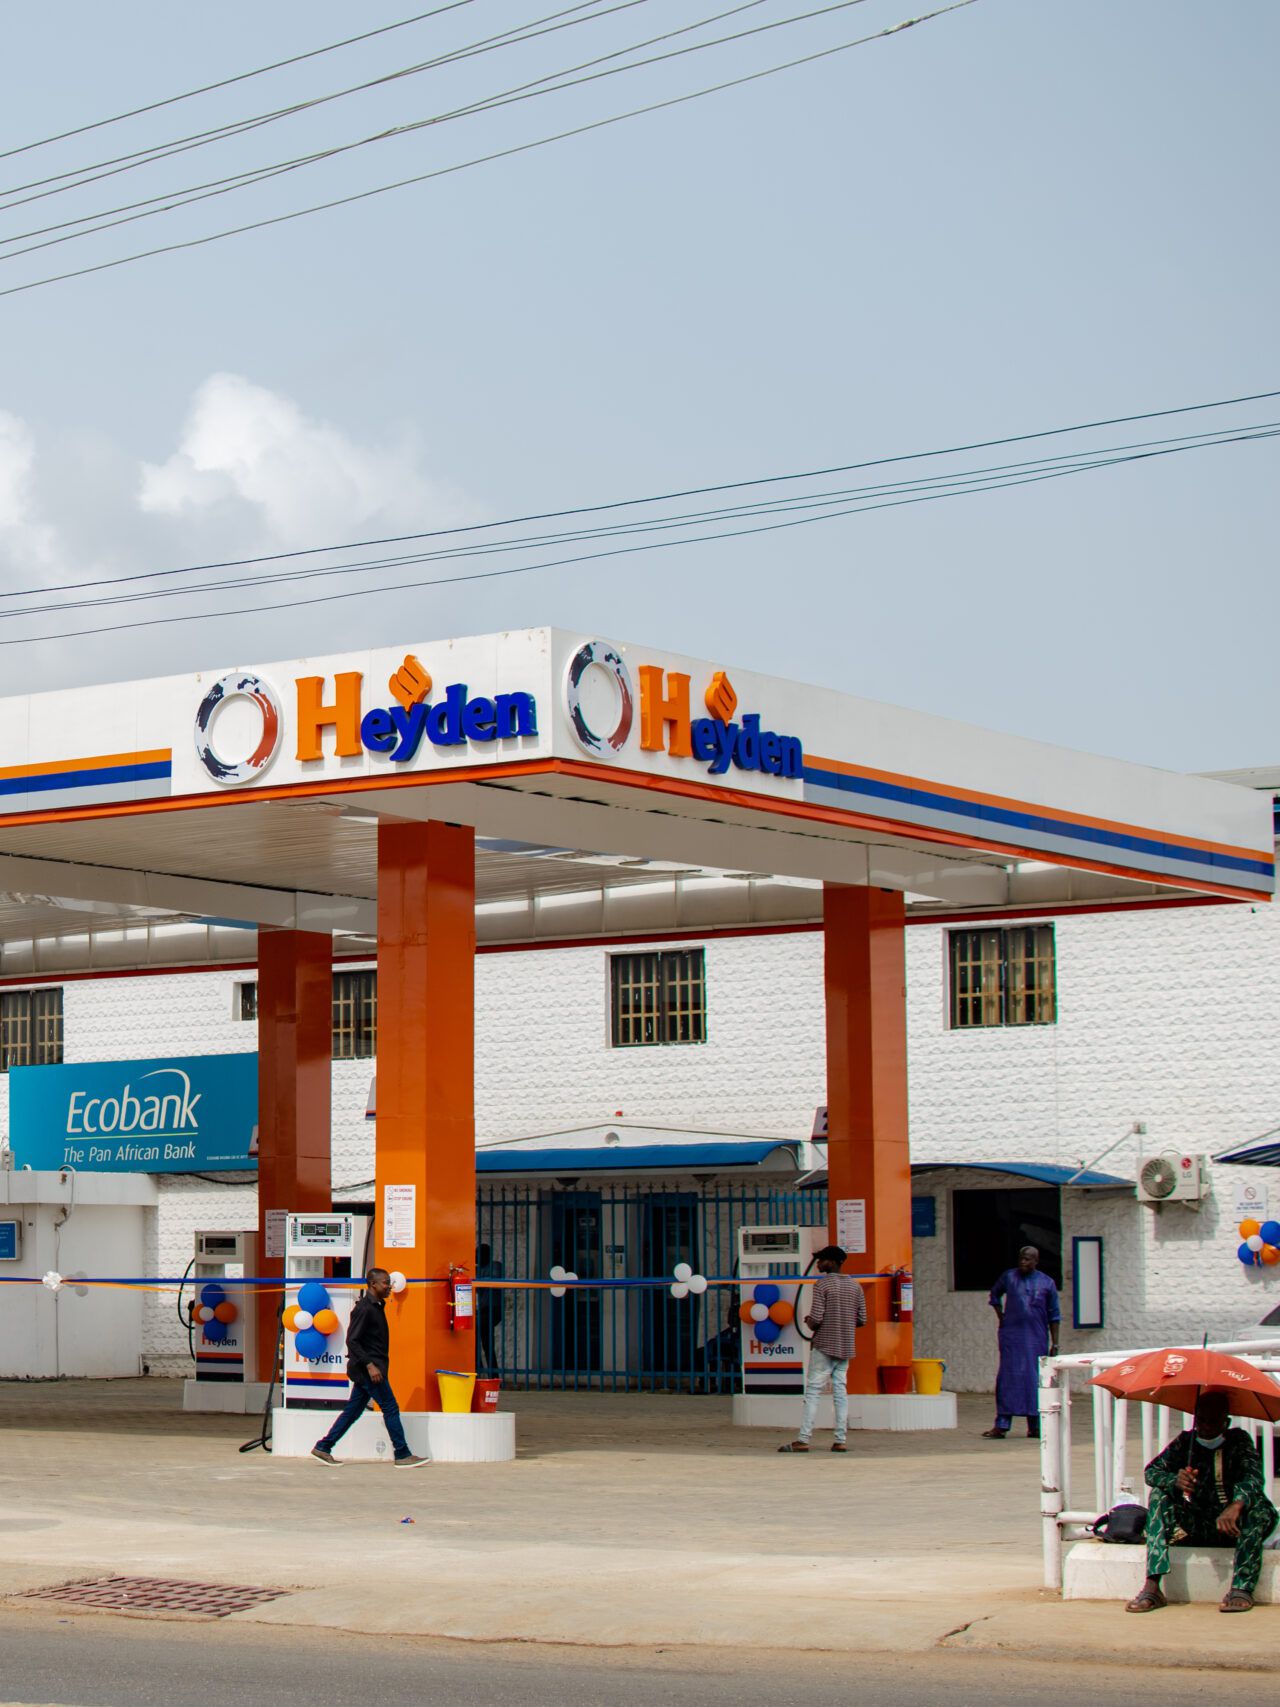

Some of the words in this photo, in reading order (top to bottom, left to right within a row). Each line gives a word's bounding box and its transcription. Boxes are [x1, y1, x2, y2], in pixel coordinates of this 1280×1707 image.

[295, 671, 539, 762] Heyden
[639, 665, 803, 779] Heyden
[66, 1069, 202, 1133] Ecobank
[64, 1146, 85, 1162] The
[89, 1146, 111, 1162] Pan
[115, 1144, 159, 1160] African
[164, 1141, 196, 1159] Bank
[750, 1340, 795, 1356] Heyden
